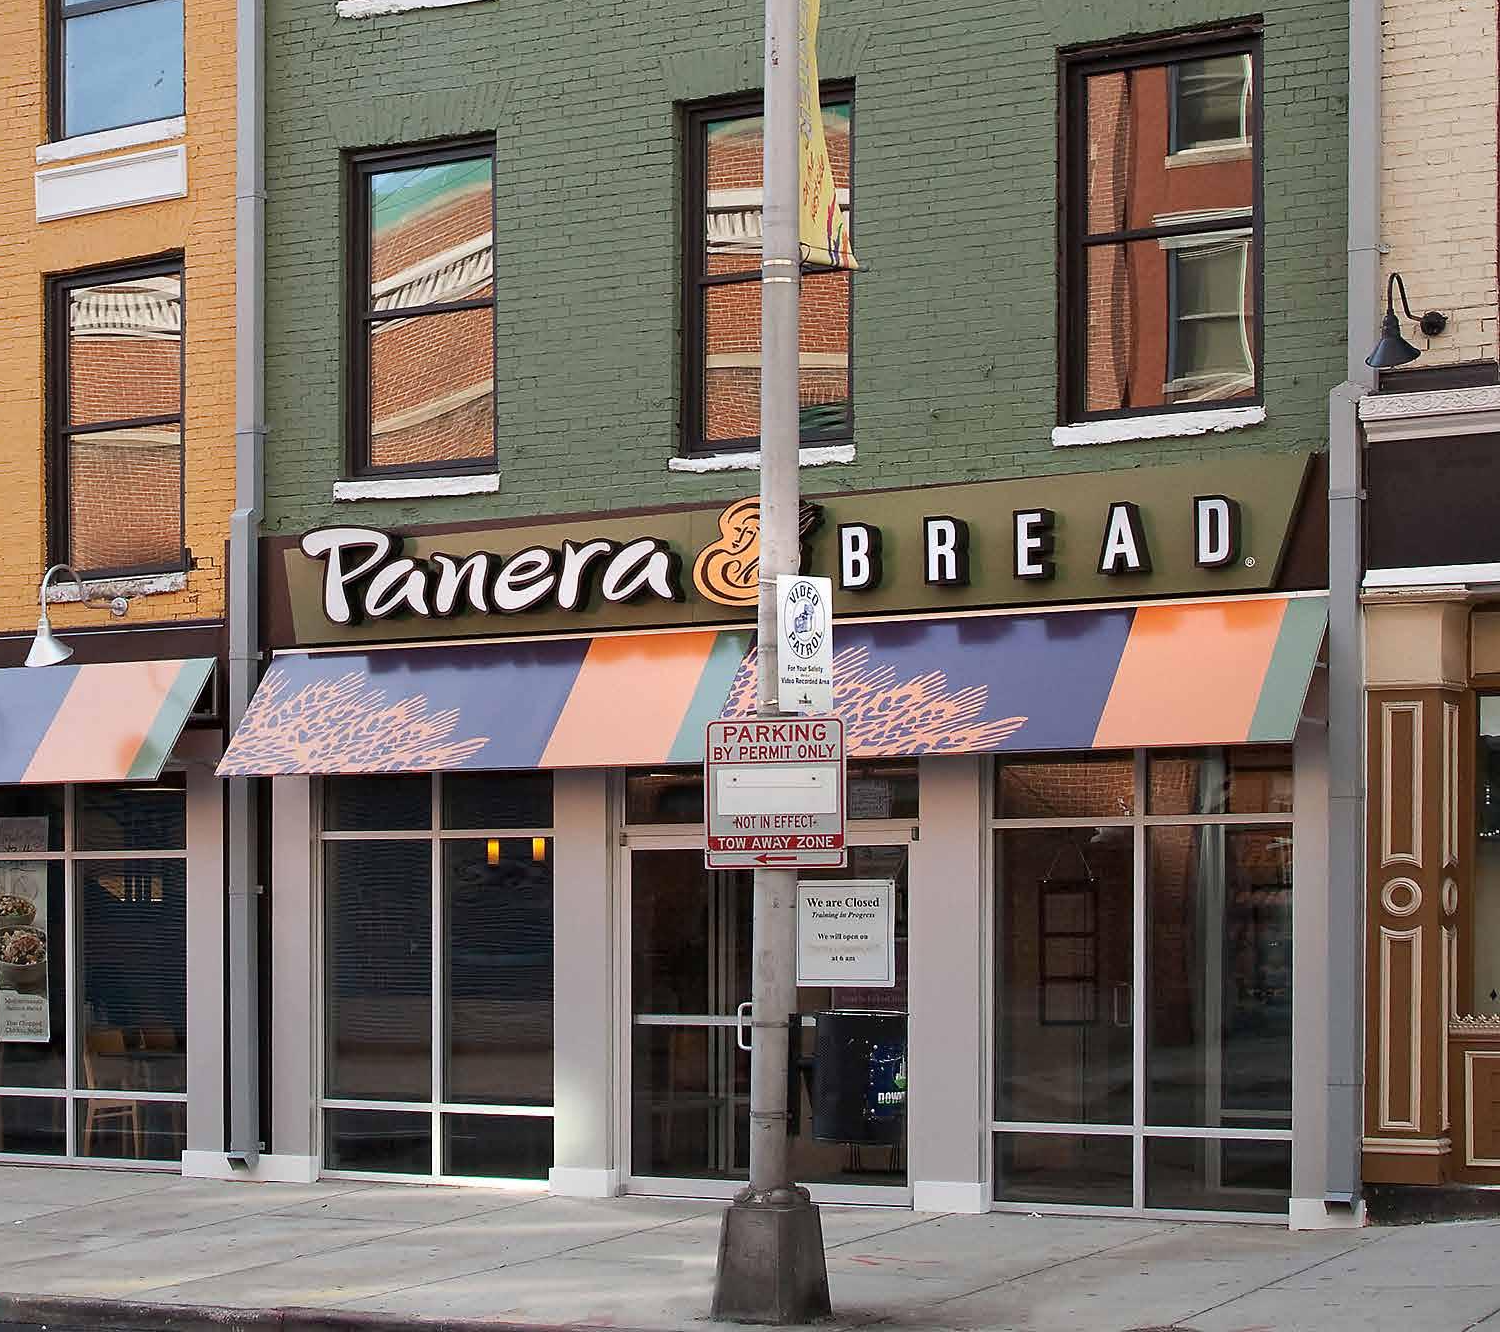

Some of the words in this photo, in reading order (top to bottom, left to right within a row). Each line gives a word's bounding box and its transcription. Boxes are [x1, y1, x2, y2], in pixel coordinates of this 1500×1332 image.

[300, 526, 676, 625] Panera
[840, 497, 1233, 588] BREAD
[789, 585, 819, 606] VIDEO
[789, 631, 822, 656] PATROL
[787, 664, 796, 672] For
[808, 665, 823, 673] Safety
[723, 723, 827, 743] PARKING
[713, 746, 733, 760] BY
[739, 745, 793, 760] PERMIT
[797, 743, 836, 759] ONLY
[760, 816, 770, 828] IN
[718, 837, 746, 850] TOW
[751, 836, 791, 849] AWAY
[796, 835, 834, 848] ZONE
[806, 898, 823, 907] We
[825, 899, 842, 907] are
[845, 897, 880, 908] Closed
[812, 911, 838, 919] Training
[847, 911, 875, 919] Progress
